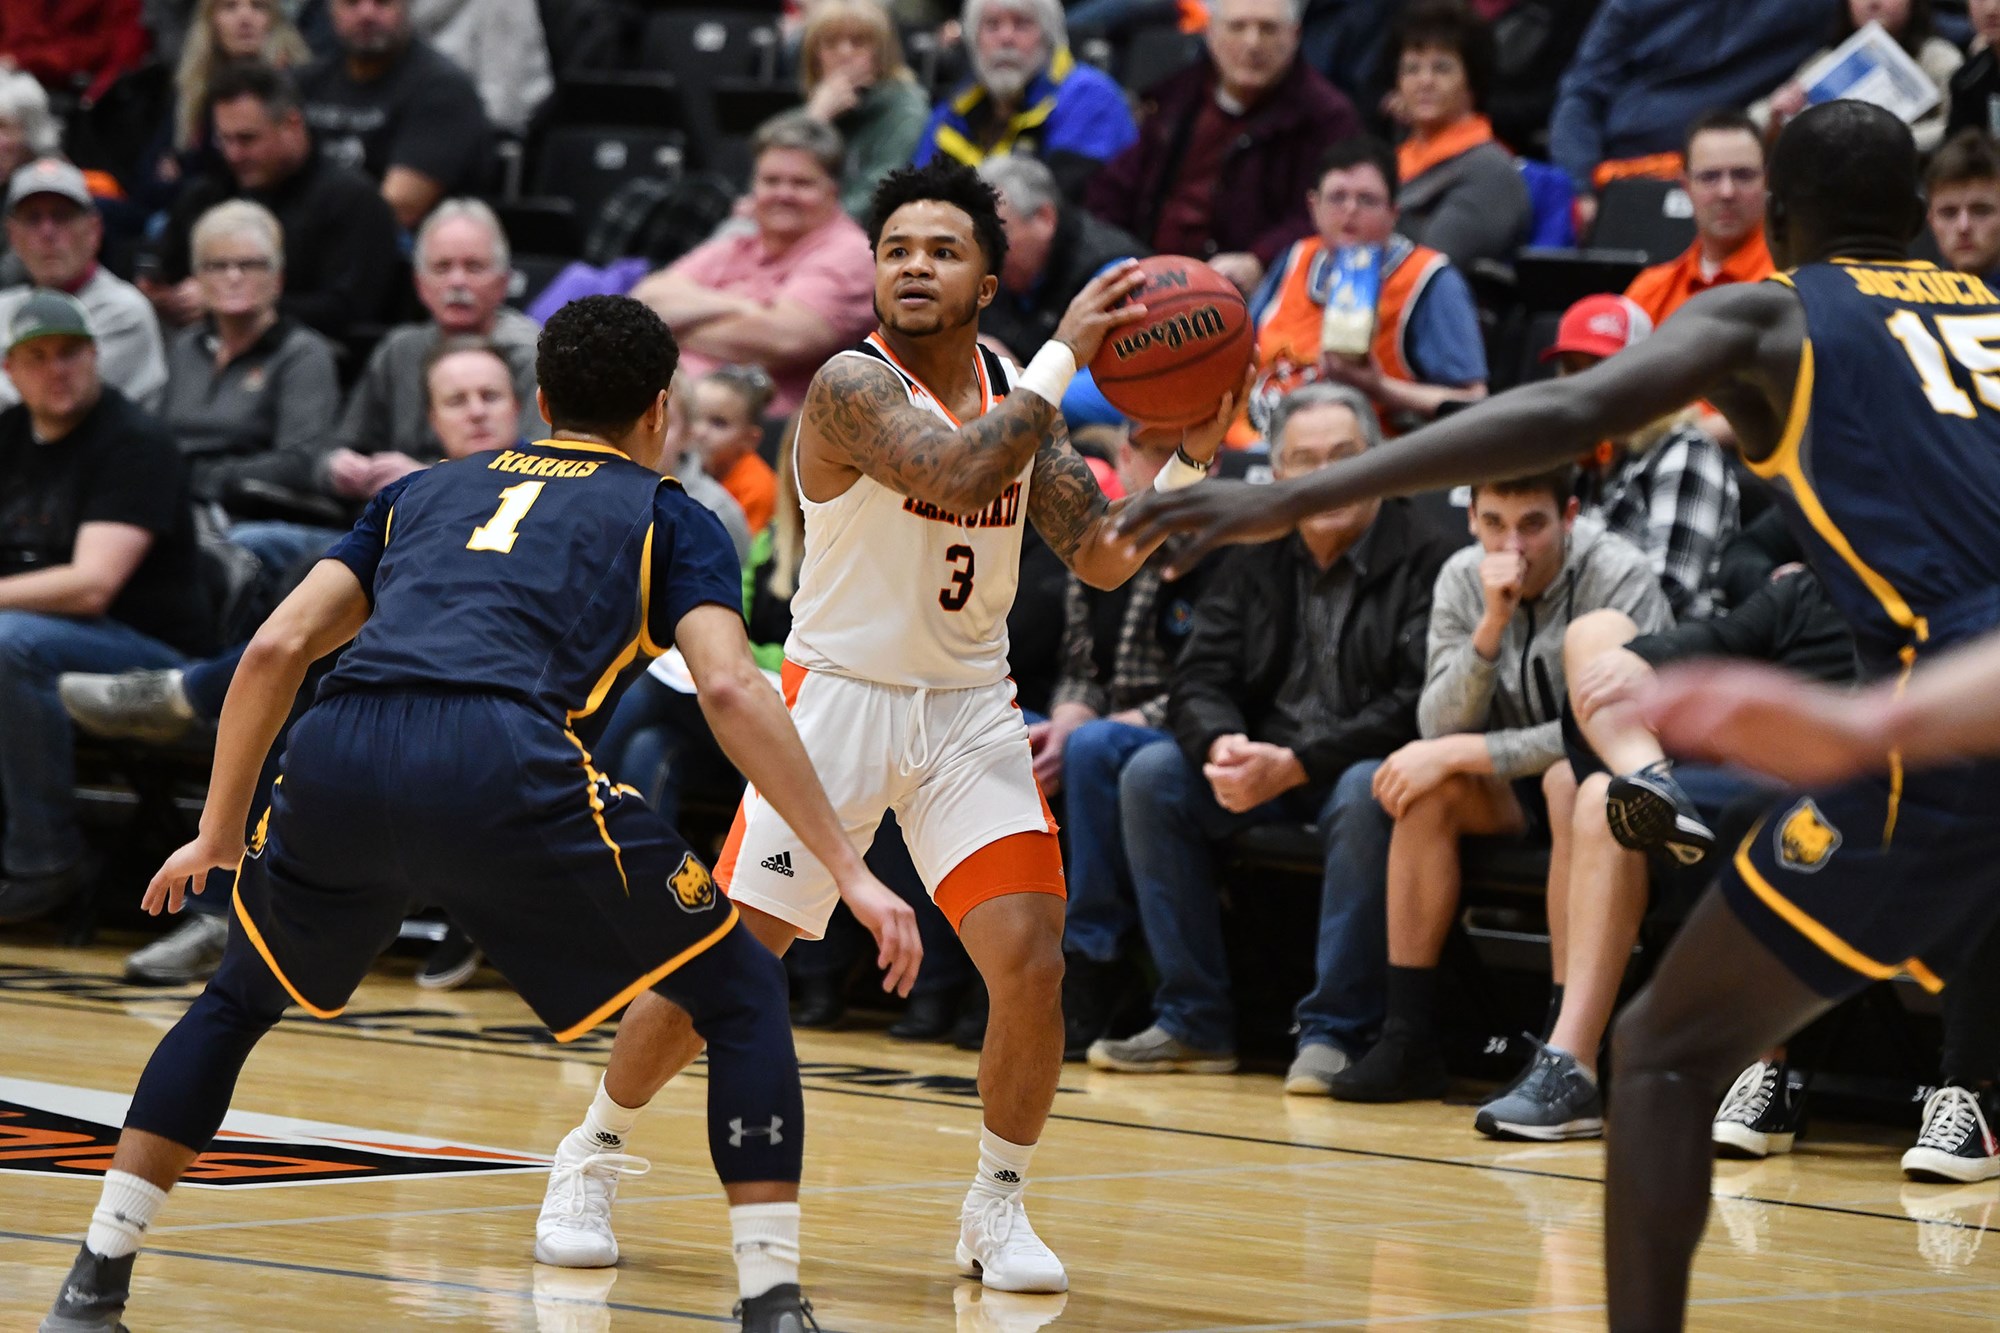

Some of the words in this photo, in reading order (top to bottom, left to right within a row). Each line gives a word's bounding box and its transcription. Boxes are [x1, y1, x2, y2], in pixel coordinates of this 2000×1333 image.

[1111, 303, 1227, 361] Wilson
[1885, 308, 2000, 419] 15
[488, 450, 608, 477] HARRIS
[466, 480, 546, 554] 1
[938, 544, 975, 611] 3
[761, 860, 795, 878] adidas
